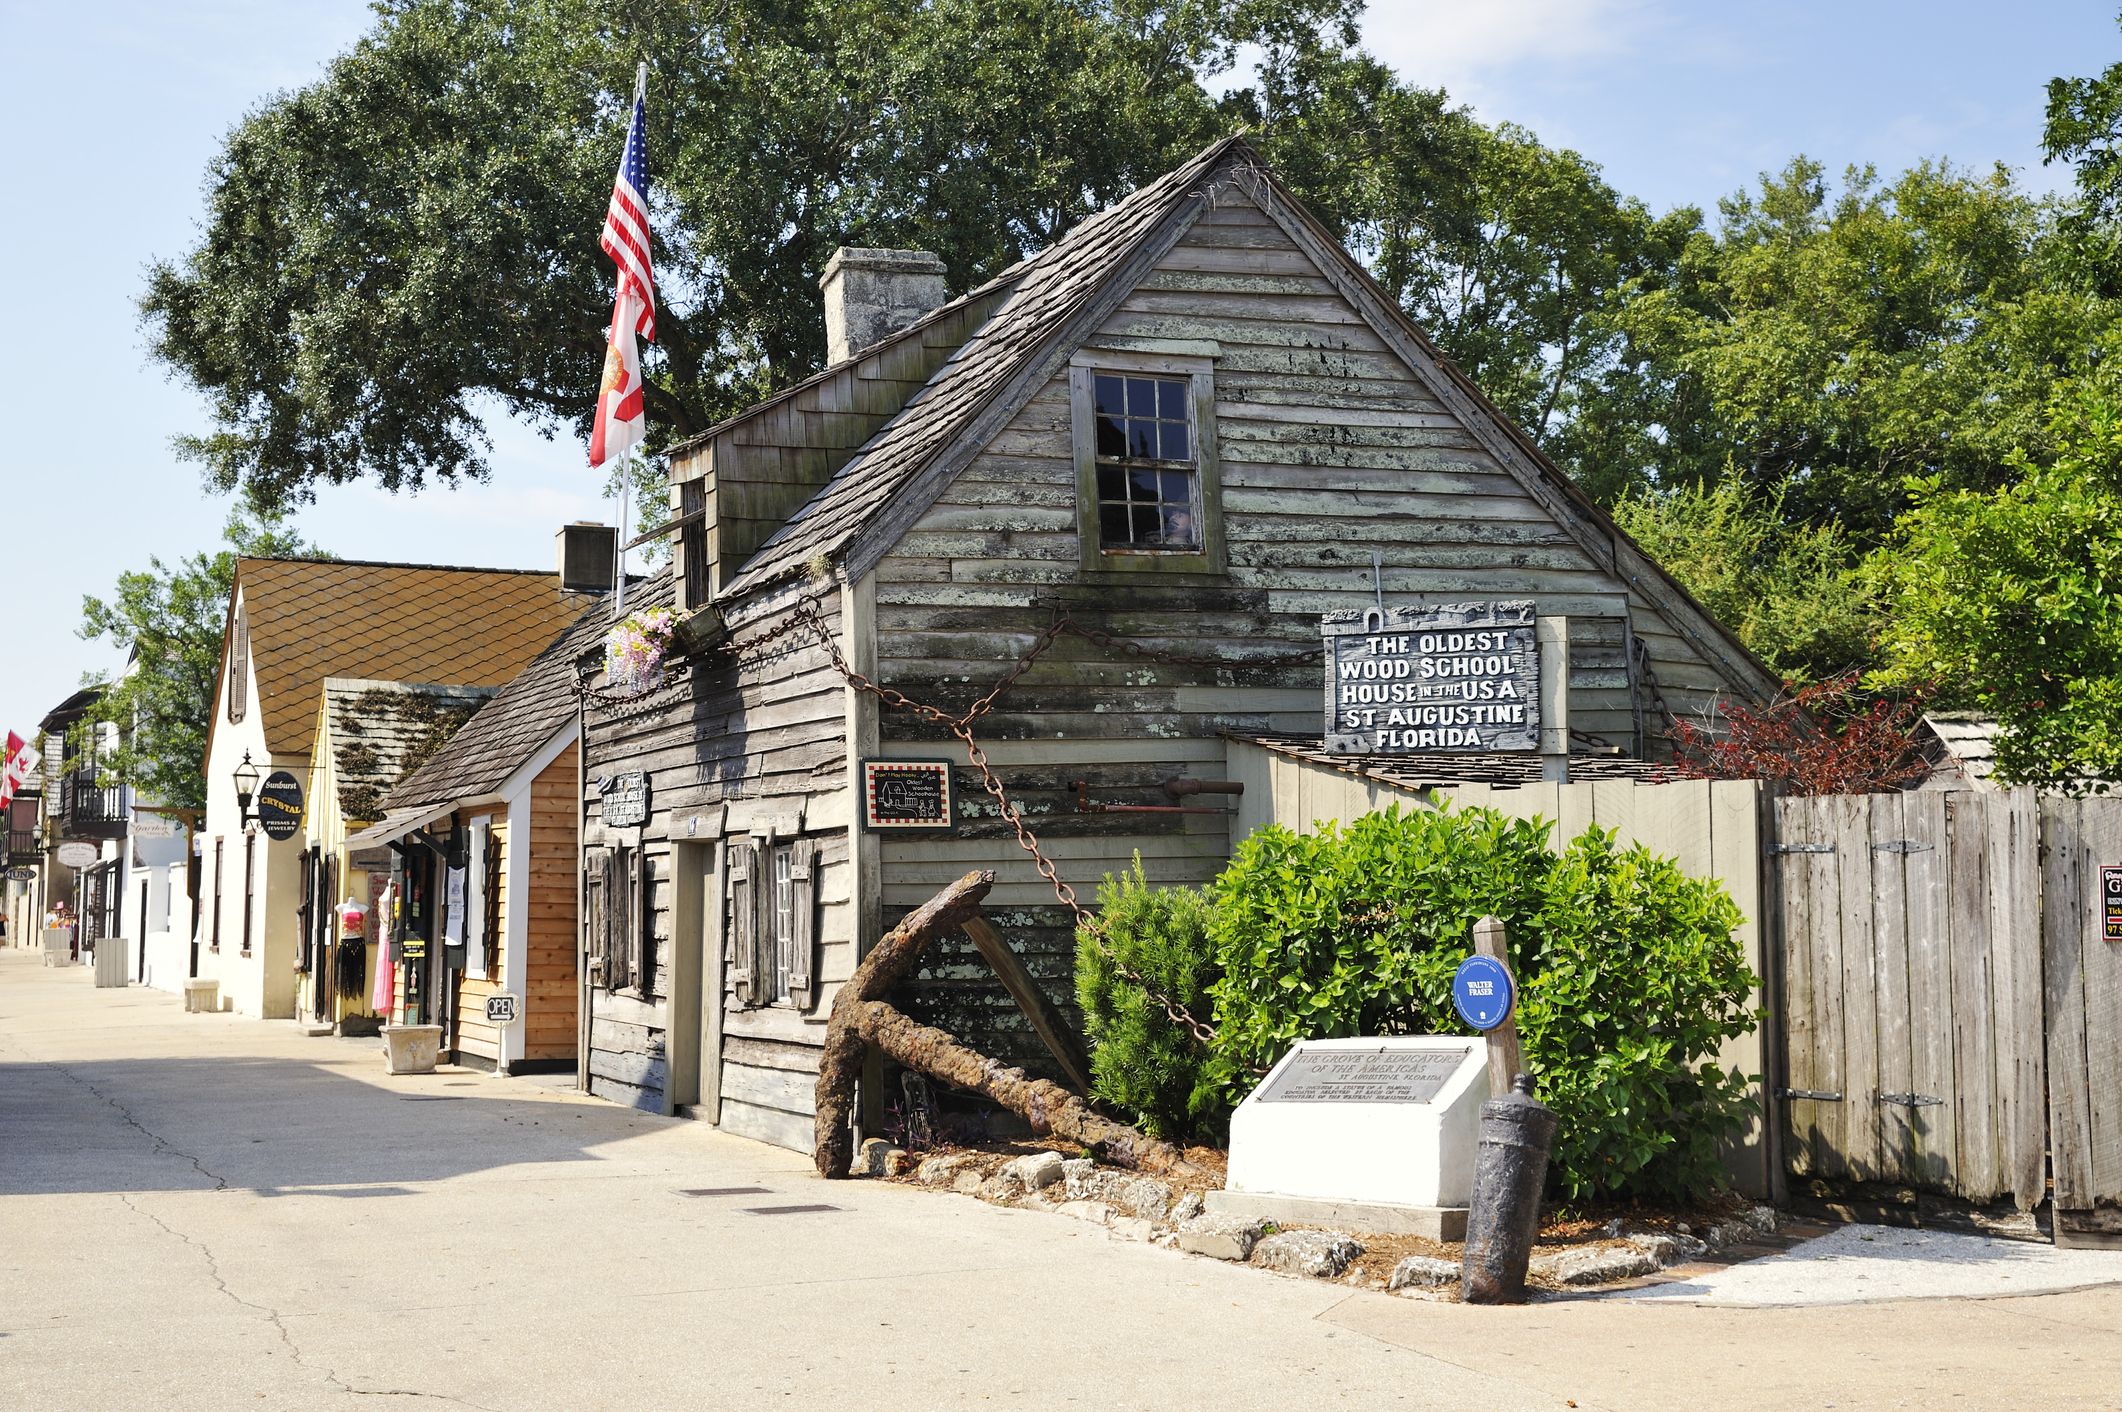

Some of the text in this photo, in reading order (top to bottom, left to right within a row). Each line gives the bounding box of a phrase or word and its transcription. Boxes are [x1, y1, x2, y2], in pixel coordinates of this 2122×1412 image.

[1366, 632, 1509, 655] THE OLDEST
[1339, 655, 1516, 680] WOOD SCHOOL
[1342, 683, 1418, 704] HOUSE
[1420, 686, 1432, 697] IN
[1436, 685, 1461, 696] THE
[1346, 704, 1524, 728] ST AUGUSTINE
[1376, 728, 1482, 748] FLORIDA
[265, 781, 297, 789] Sunburst
[261, 797, 301, 813] CRYSTAL
[2107, 925, 2116, 933] 97
[1469, 988, 1493, 996] FRASER
[488, 999, 515, 1014] OPEN
[1296, 1054, 1461, 1064] THE GROVE OF EDUCATORS
[1311, 1064, 1427, 1073] OF THE AMERICAS
